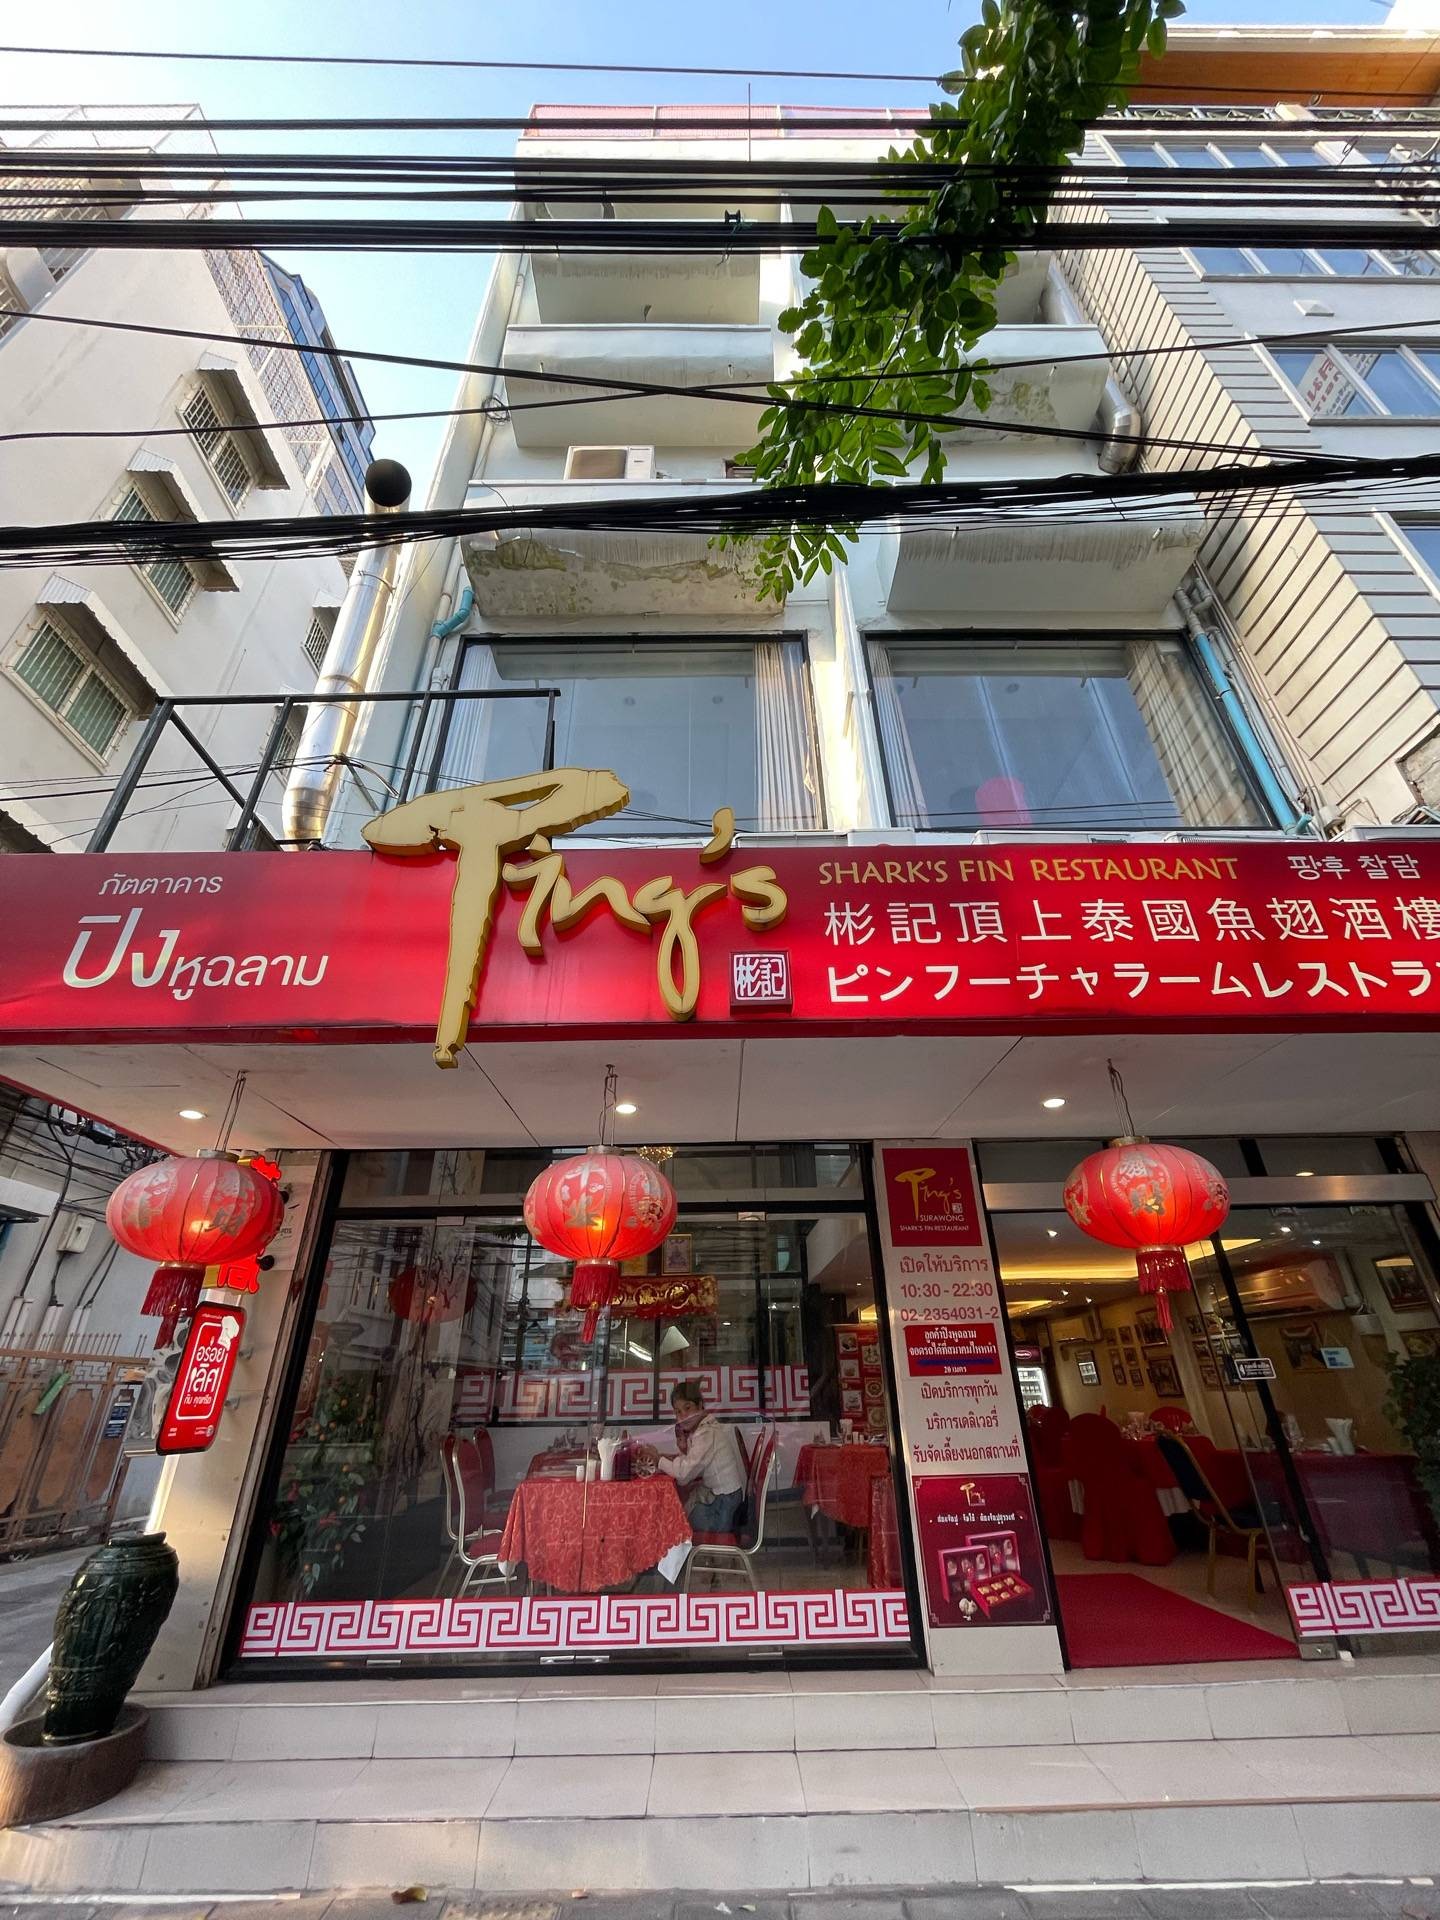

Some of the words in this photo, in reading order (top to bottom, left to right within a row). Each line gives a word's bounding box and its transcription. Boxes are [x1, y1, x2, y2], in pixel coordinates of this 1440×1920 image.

[818, 860, 949, 885] SHARK'S
[959, 859, 1015, 882] FIN
[1030, 857, 1239, 881] RESTAURANT
[1357, 854, 1421, 879] 찰람
[98, 872, 224, 896] ภัตตาคาร
[827, 961, 1440, 1003] ピンフーチャラームレストラ
[919, 1214, 965, 1222] SURAWONG
[900, 1253, 988, 1273] เปิดให้บริการ
[901, 1283, 941, 1298] 10:30
[952, 1282, 993, 1297] 22:30
[901, 1306, 999, 1321] 02-2354031-2
[196, 1336, 225, 1362] อร่อย
[188, 1363, 220, 1392] เลิศ
[921, 1379, 999, 1404] เปิดบริการทุกวัน
[913, 1435, 1021, 1463] รับจัดเลี้ยงนอกสถานที่
